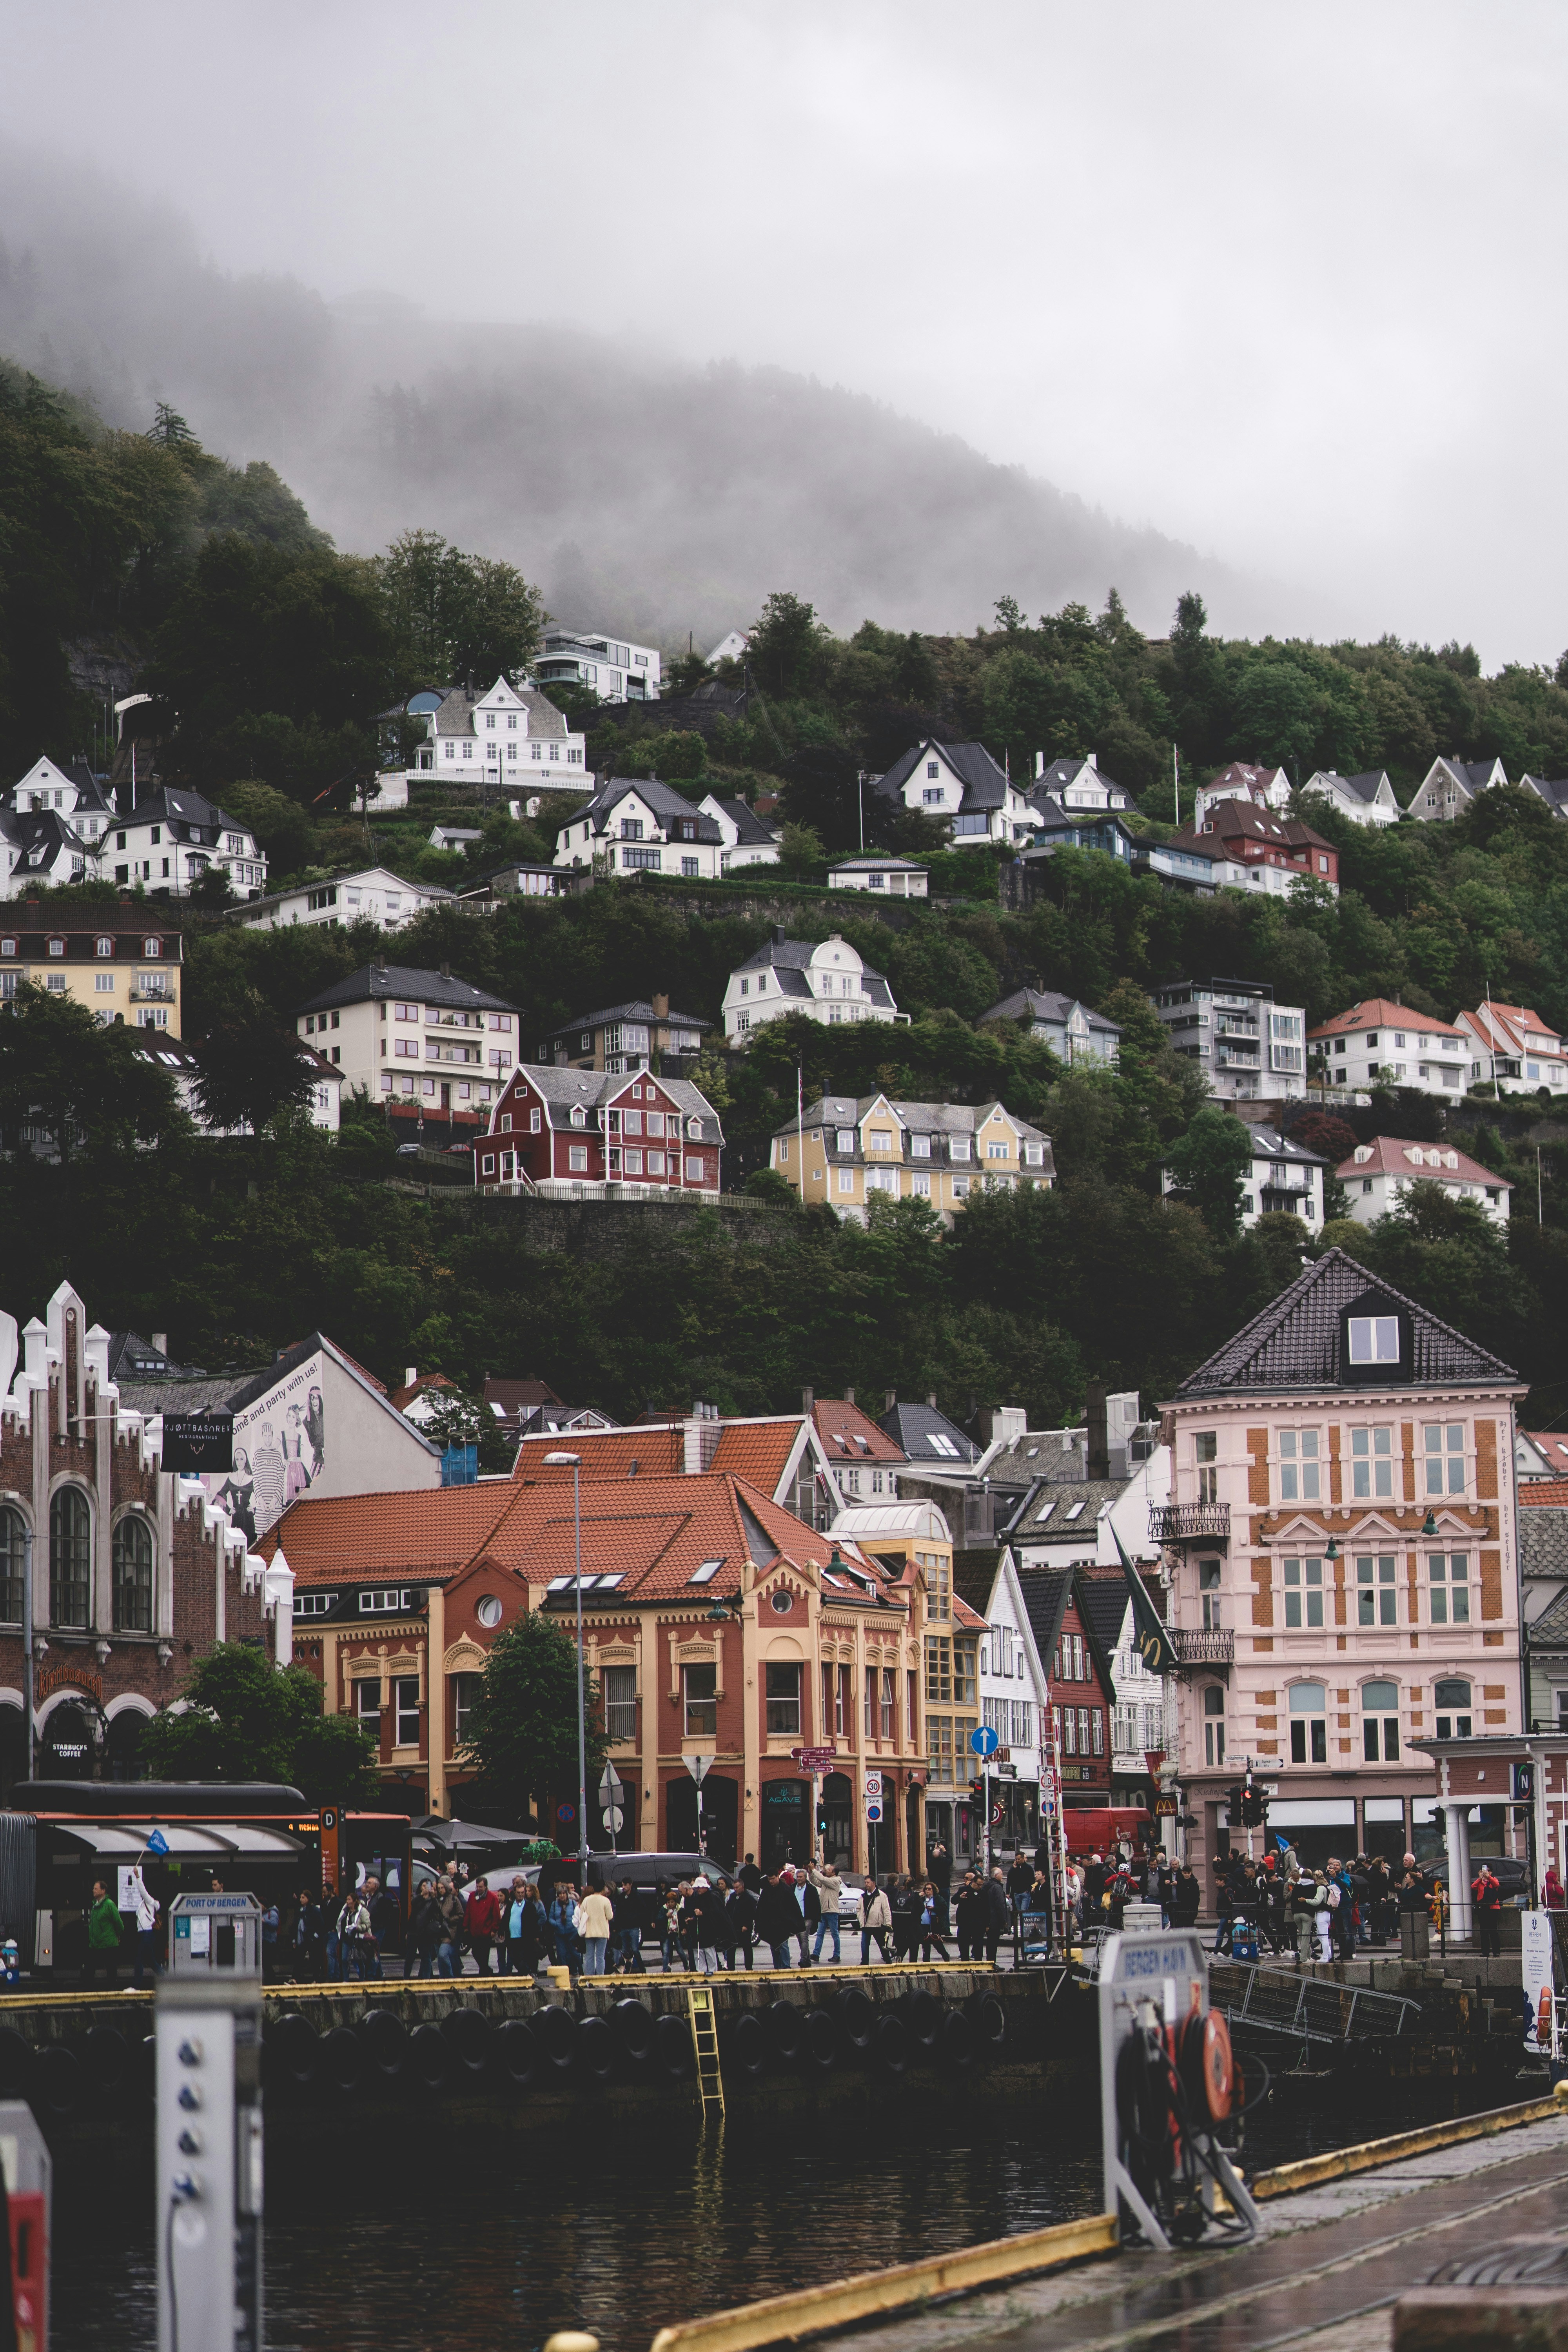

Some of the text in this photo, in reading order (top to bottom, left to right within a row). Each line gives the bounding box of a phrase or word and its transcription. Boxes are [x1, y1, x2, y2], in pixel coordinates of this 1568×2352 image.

[232, 1363, 318, 1435] ome and party with us!
[1521, 1775, 1528, 1789] N
[326, 1813, 333, 1826] D
[186, 1898, 246, 1908] PORT OF BERGEN
[1125, 1946, 1187, 1977] BERGEN HAVN
